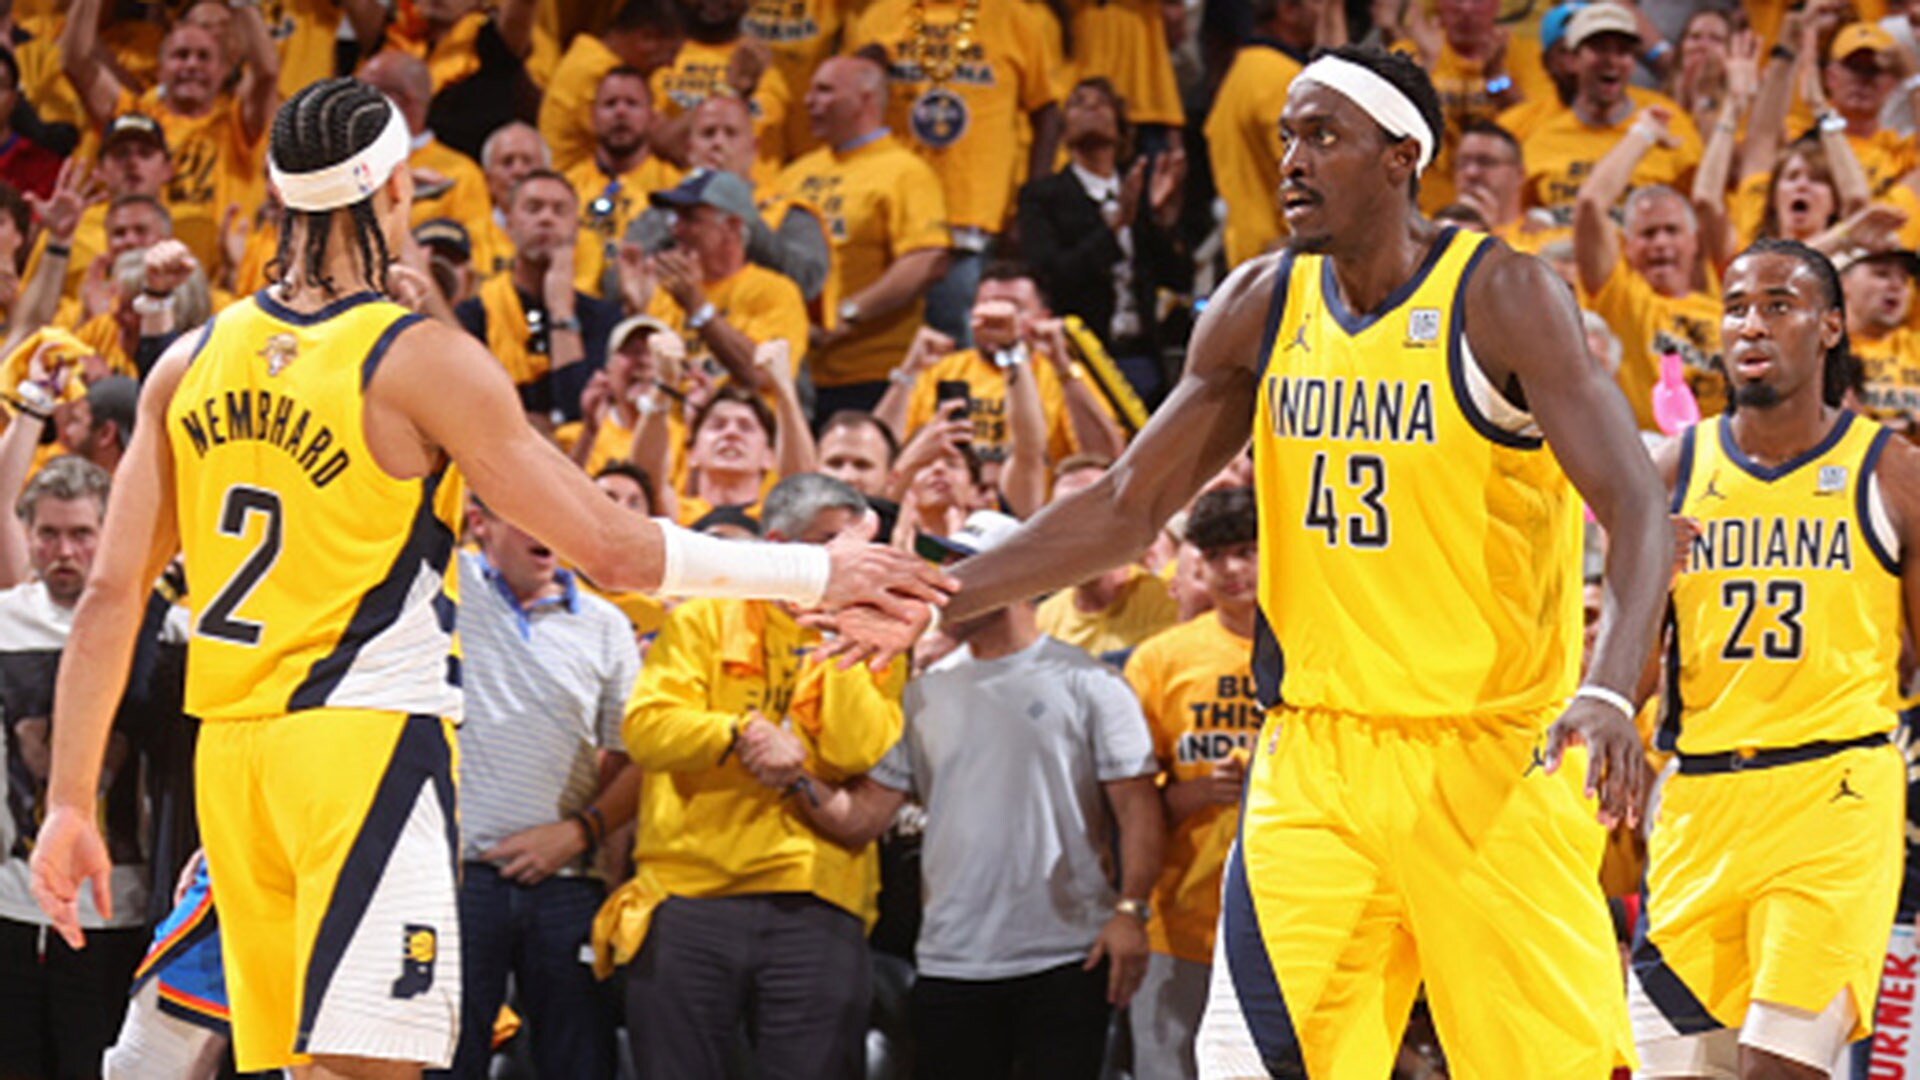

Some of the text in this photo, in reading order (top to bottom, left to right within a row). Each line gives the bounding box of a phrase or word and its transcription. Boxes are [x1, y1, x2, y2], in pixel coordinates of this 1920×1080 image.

[180, 389, 350, 489] NEMBHARD
[1269, 376, 1436, 442] INDIANA
[1304, 453, 1389, 548] 43
[1682, 516, 1852, 573] NDIANA
[195, 483, 283, 648] 2
[1721, 579, 1804, 661] 23
